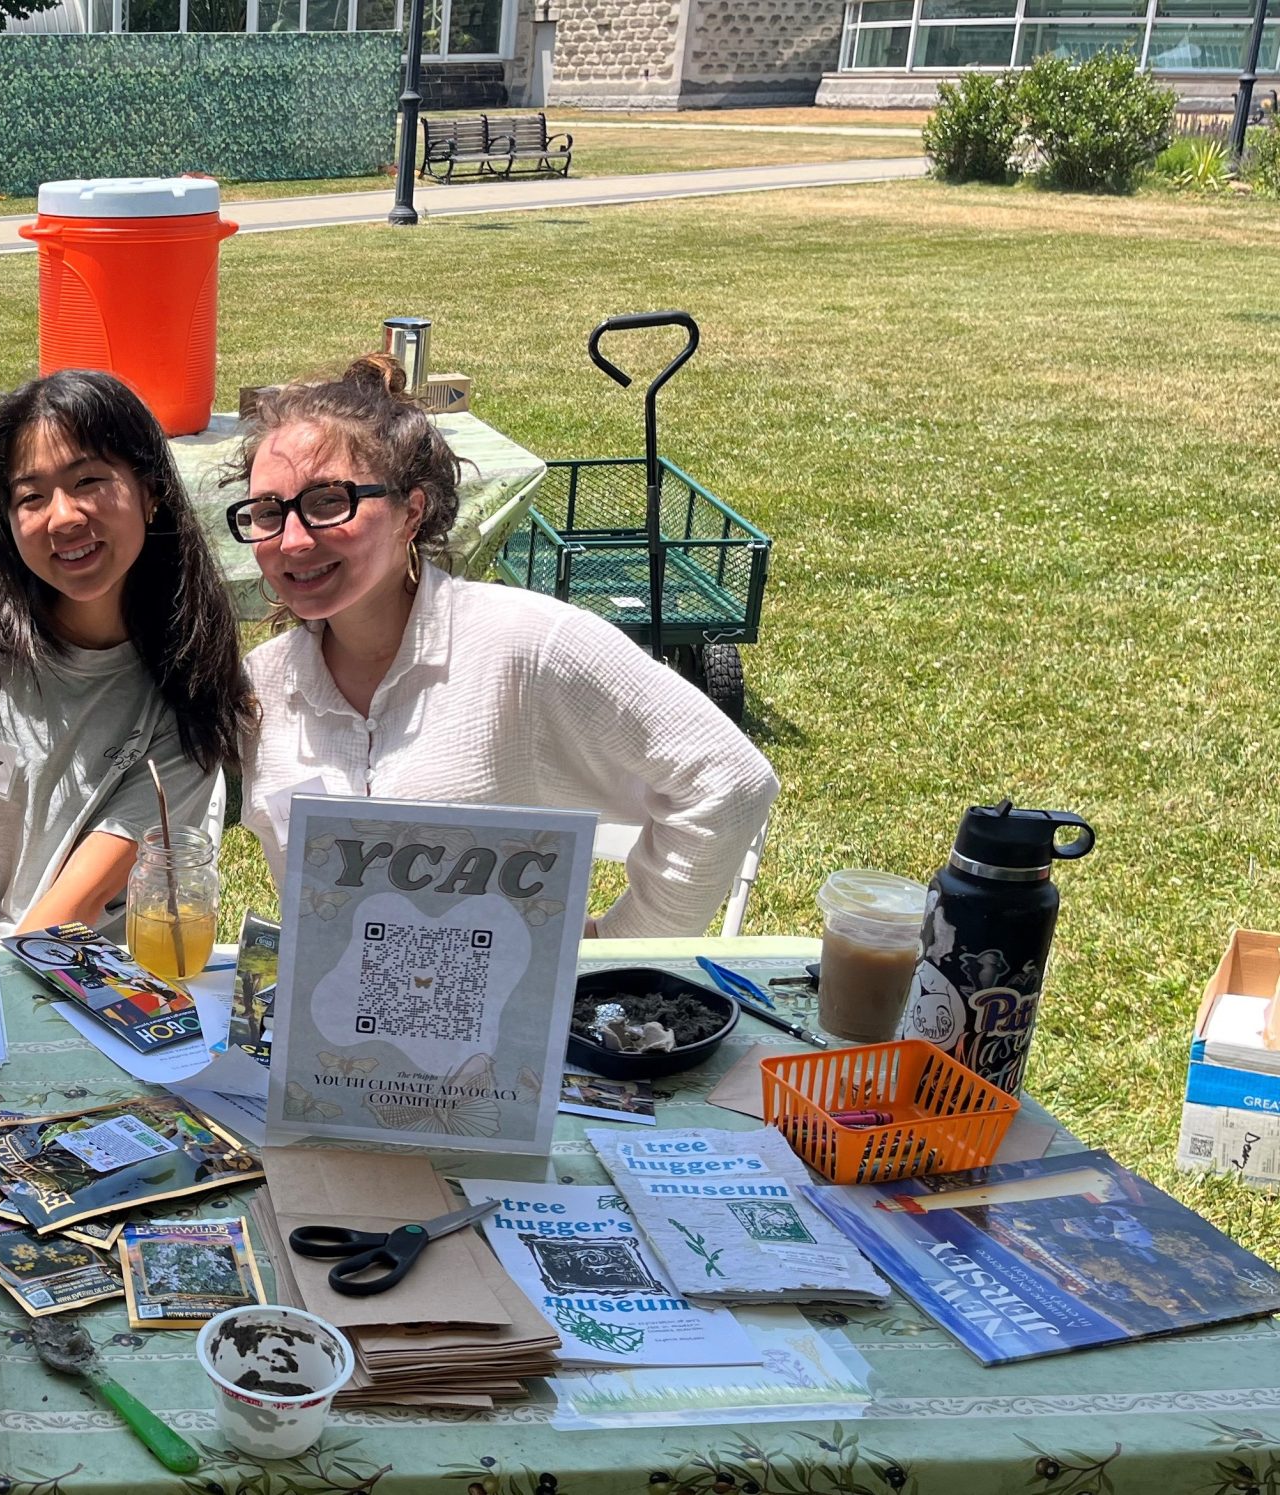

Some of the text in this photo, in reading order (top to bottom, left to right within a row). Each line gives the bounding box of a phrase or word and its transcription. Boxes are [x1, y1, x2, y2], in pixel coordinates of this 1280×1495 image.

[334, 838, 558, 899] YCAC
[974, 992, 1035, 1033] Pit
[397, 1070, 411, 1079] The
[312, 1074, 521, 1101] YOUTH CLIMATE ADVOCACY
[369, 1093, 460, 1110] COMMITTEE
[644, 1141, 708, 1153] tree
[627, 1157, 763, 1175] hugger's
[650, 1182, 789, 1197] museum
[500, 1198, 567, 1214] tree
[135, 1223, 230, 1236] EVERWILDE
[494, 1214, 634, 1236] hugger's
[974, 1248, 1032, 1293] experience
[914, 1239, 1061, 1336] JERSEY
[543, 1296, 691, 1313] museum
[920, 1276, 1020, 1340] NEW
[1066, 1317, 1081, 1328] A
